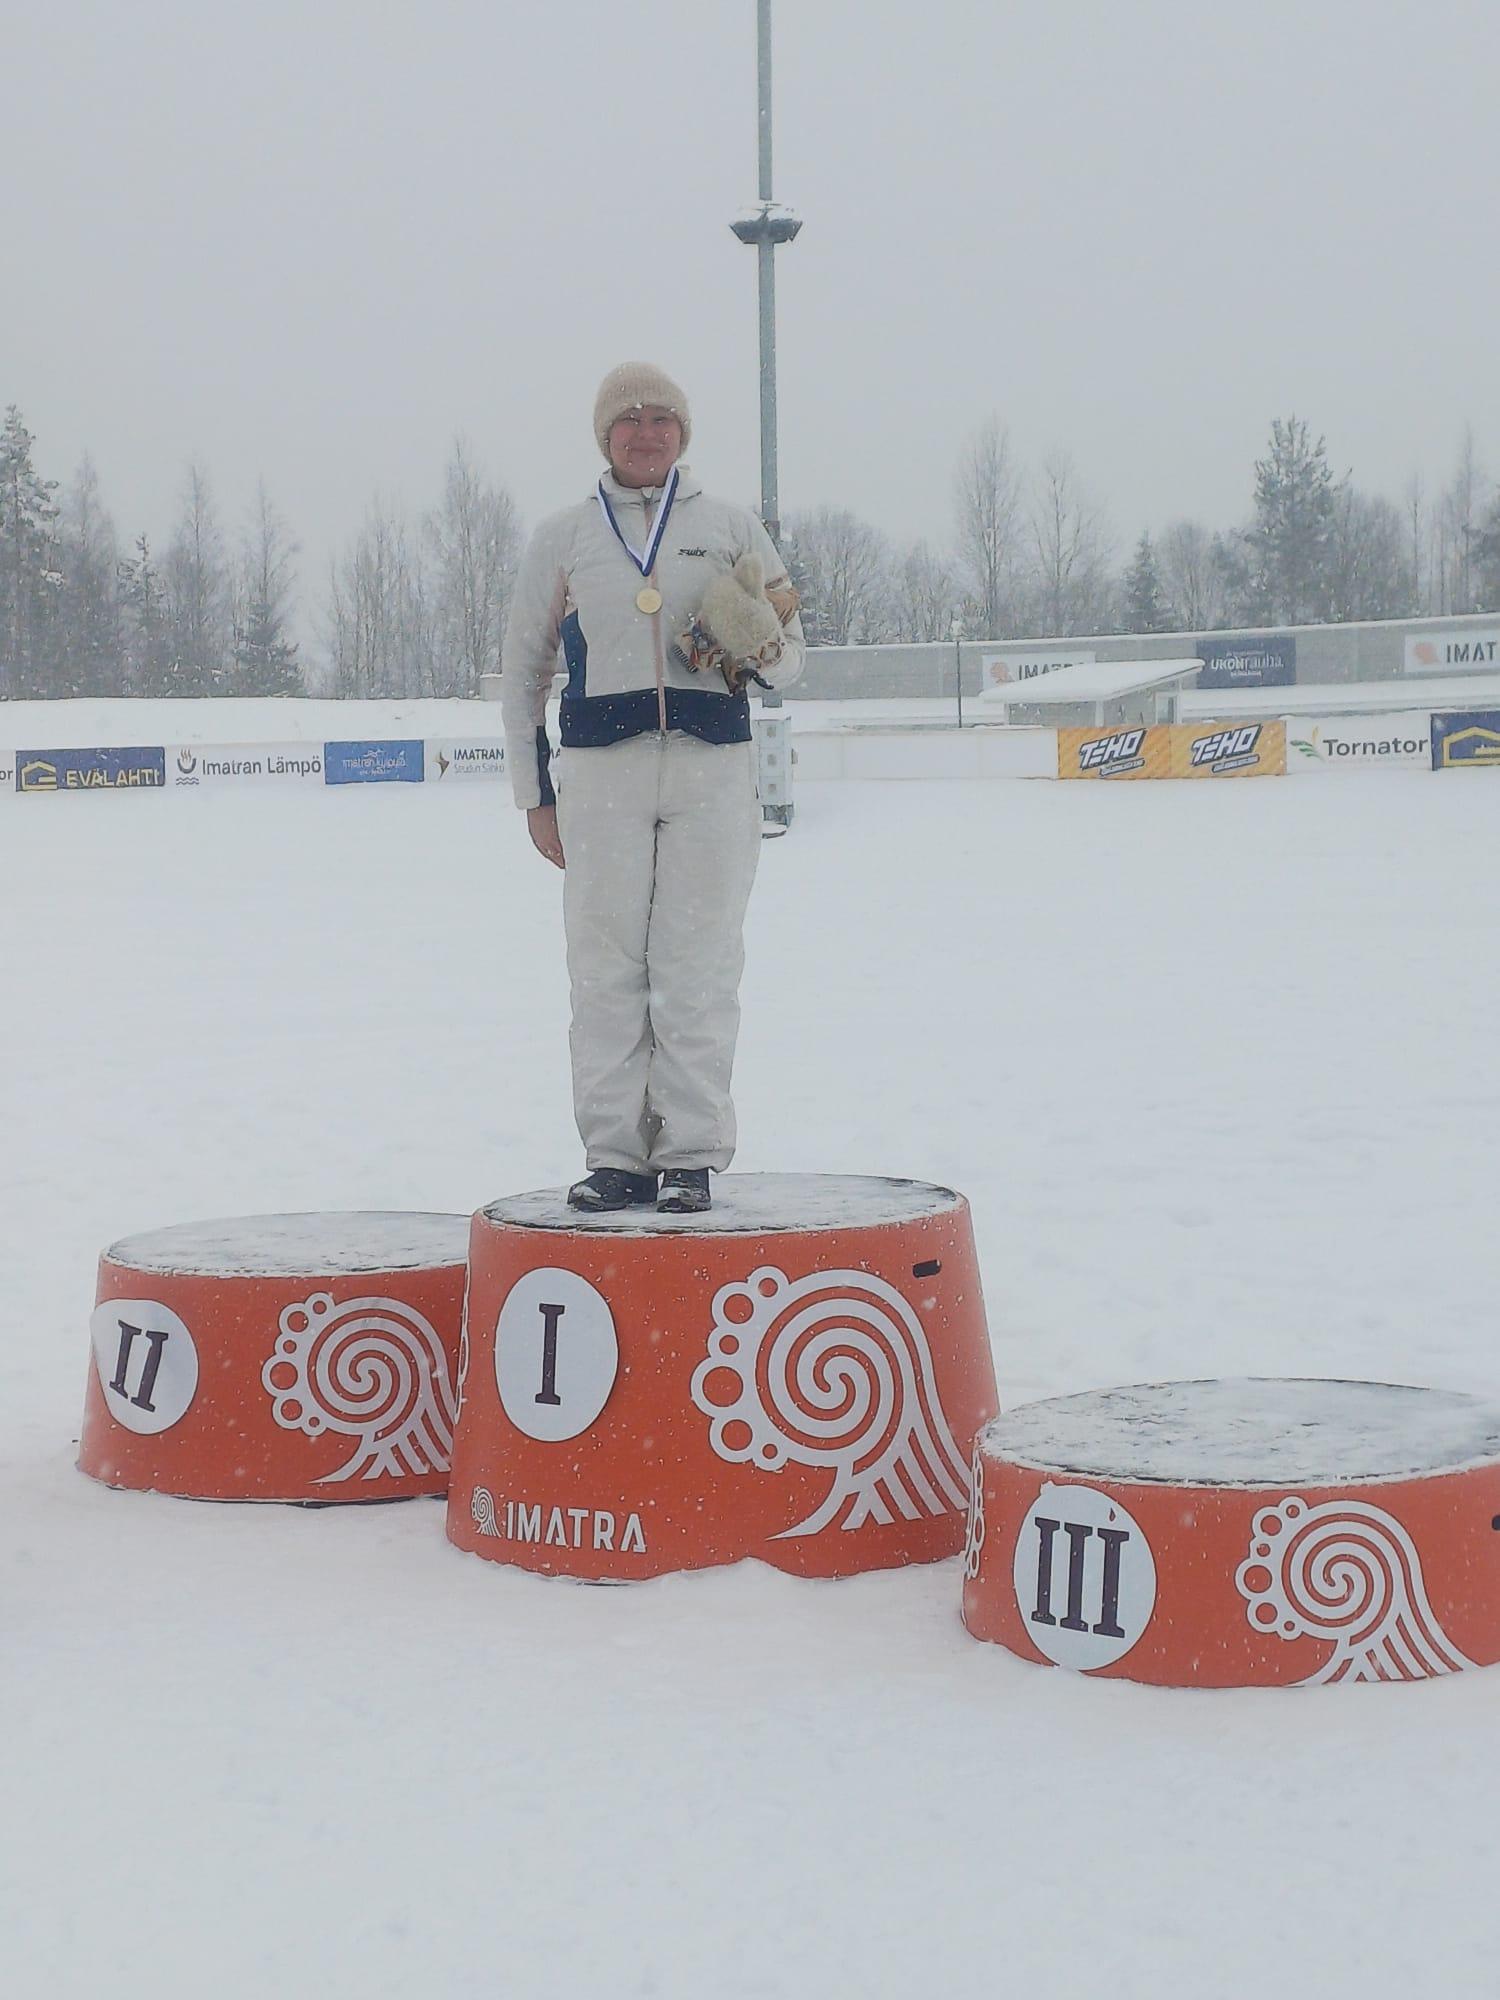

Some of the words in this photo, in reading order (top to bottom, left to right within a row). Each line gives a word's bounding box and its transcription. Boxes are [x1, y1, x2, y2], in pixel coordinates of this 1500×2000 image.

[454, 748, 505, 760] IMATRAN
[1080, 729, 1146, 768] TEHO
[1192, 725, 1262, 766] TEHO
[1322, 737, 1429, 756] Tornator
[66, 767, 160, 787] EVÄLAHTI
[202, 759, 261, 776] Imatran
[267, 755, 322, 777] Lämpö
[109, 1319, 168, 1413] II
[506, 1500, 648, 1553] IMATRA
[1031, 1516, 1130, 1639] III
